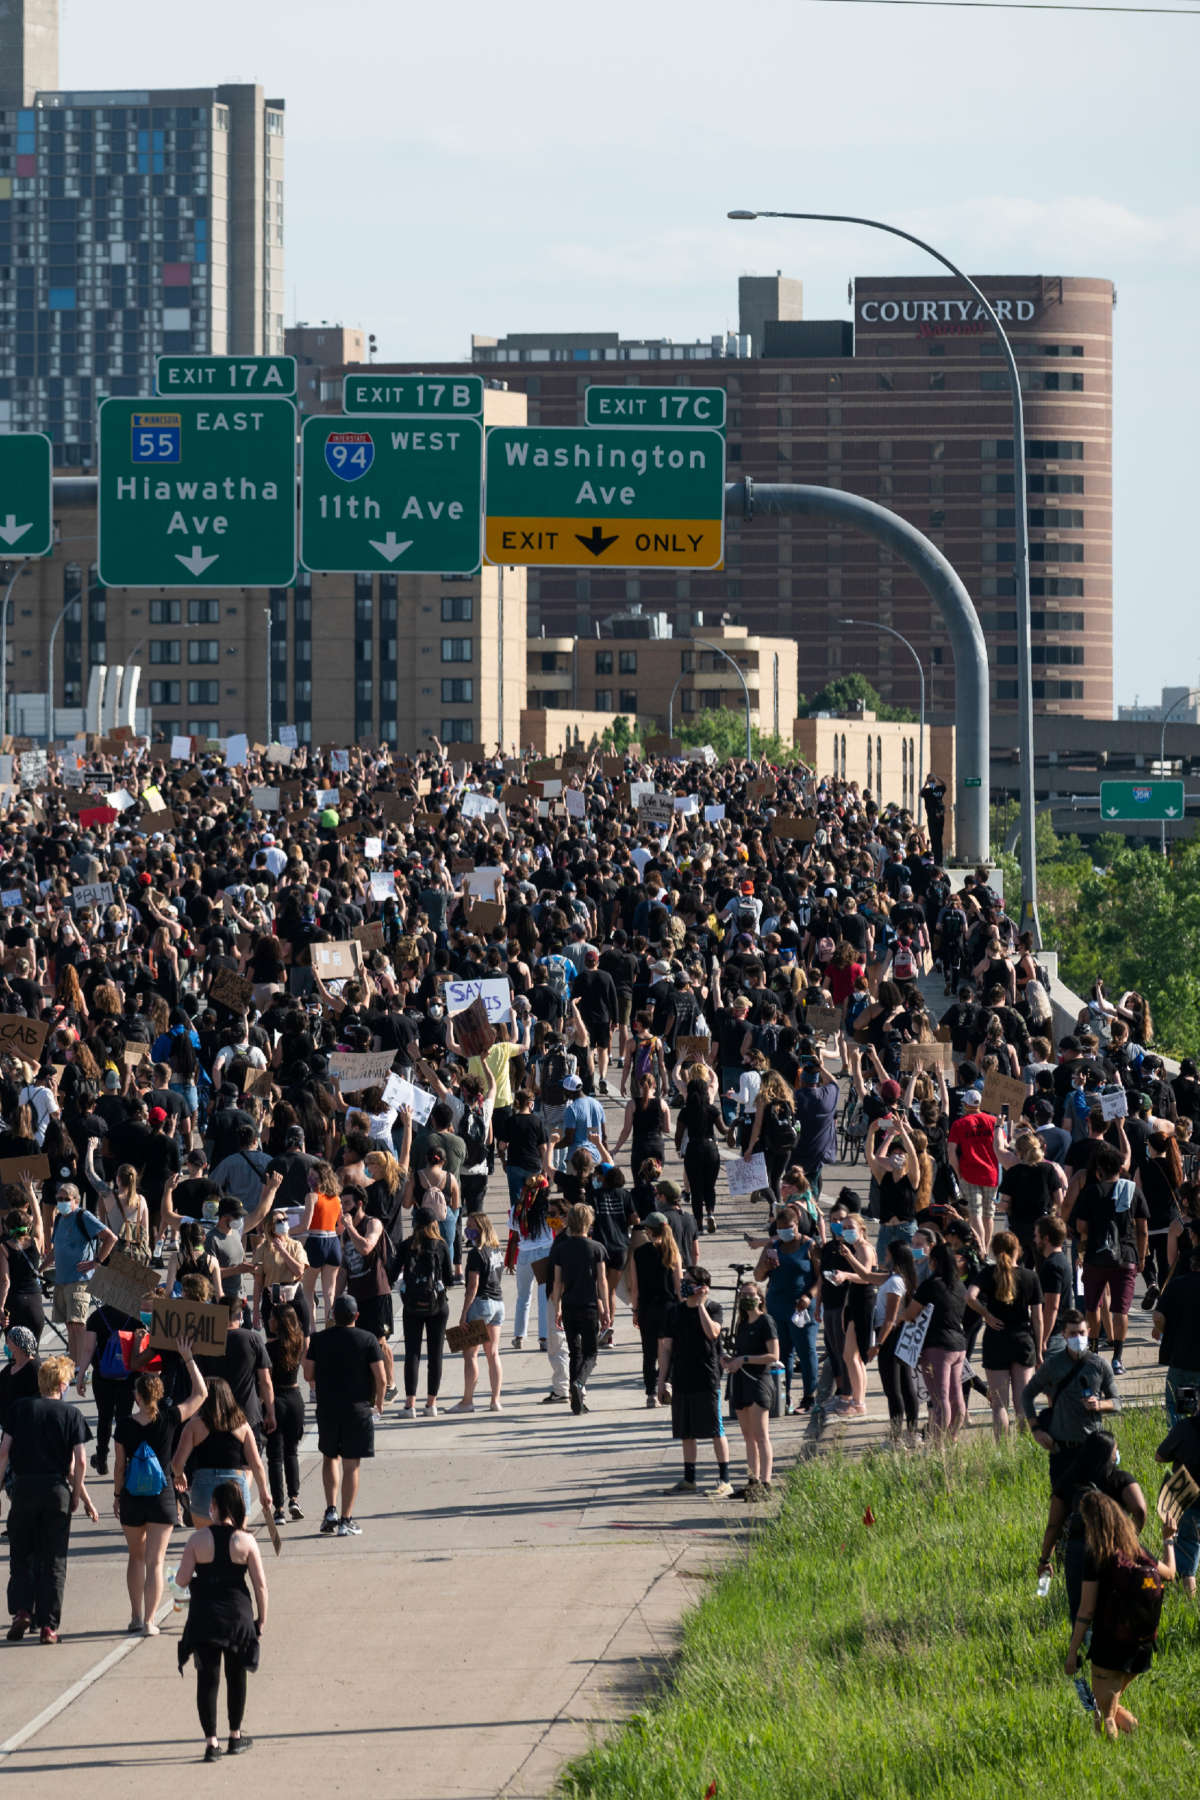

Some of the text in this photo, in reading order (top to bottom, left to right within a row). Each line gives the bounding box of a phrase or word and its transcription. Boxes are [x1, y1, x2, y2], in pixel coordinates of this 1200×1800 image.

[861, 300, 1035, 322] COURTYARD
[169, 365, 284, 387] EXIT 17A
[356, 384, 471, 407] EXIT 17B
[600, 396, 711, 419] EXIT 17C
[196, 413, 264, 431] EAST
[140, 433, 174, 457] 55
[391, 432, 460, 451] WEST
[332, 446, 367, 469] 94
[505, 442, 706, 476] Washington
[117, 476, 278, 500] Hiawatha
[575, 481, 636, 505] Ave
[319, 494, 464, 520] 11th Ave
[166, 511, 228, 534] Ave
[502, 531, 704, 553] EXIT ONLY
[75, 885, 112, 904] #BLM
[449, 982, 483, 1002] SAY
[151, 1309, 226, 1345] NO BAIL
